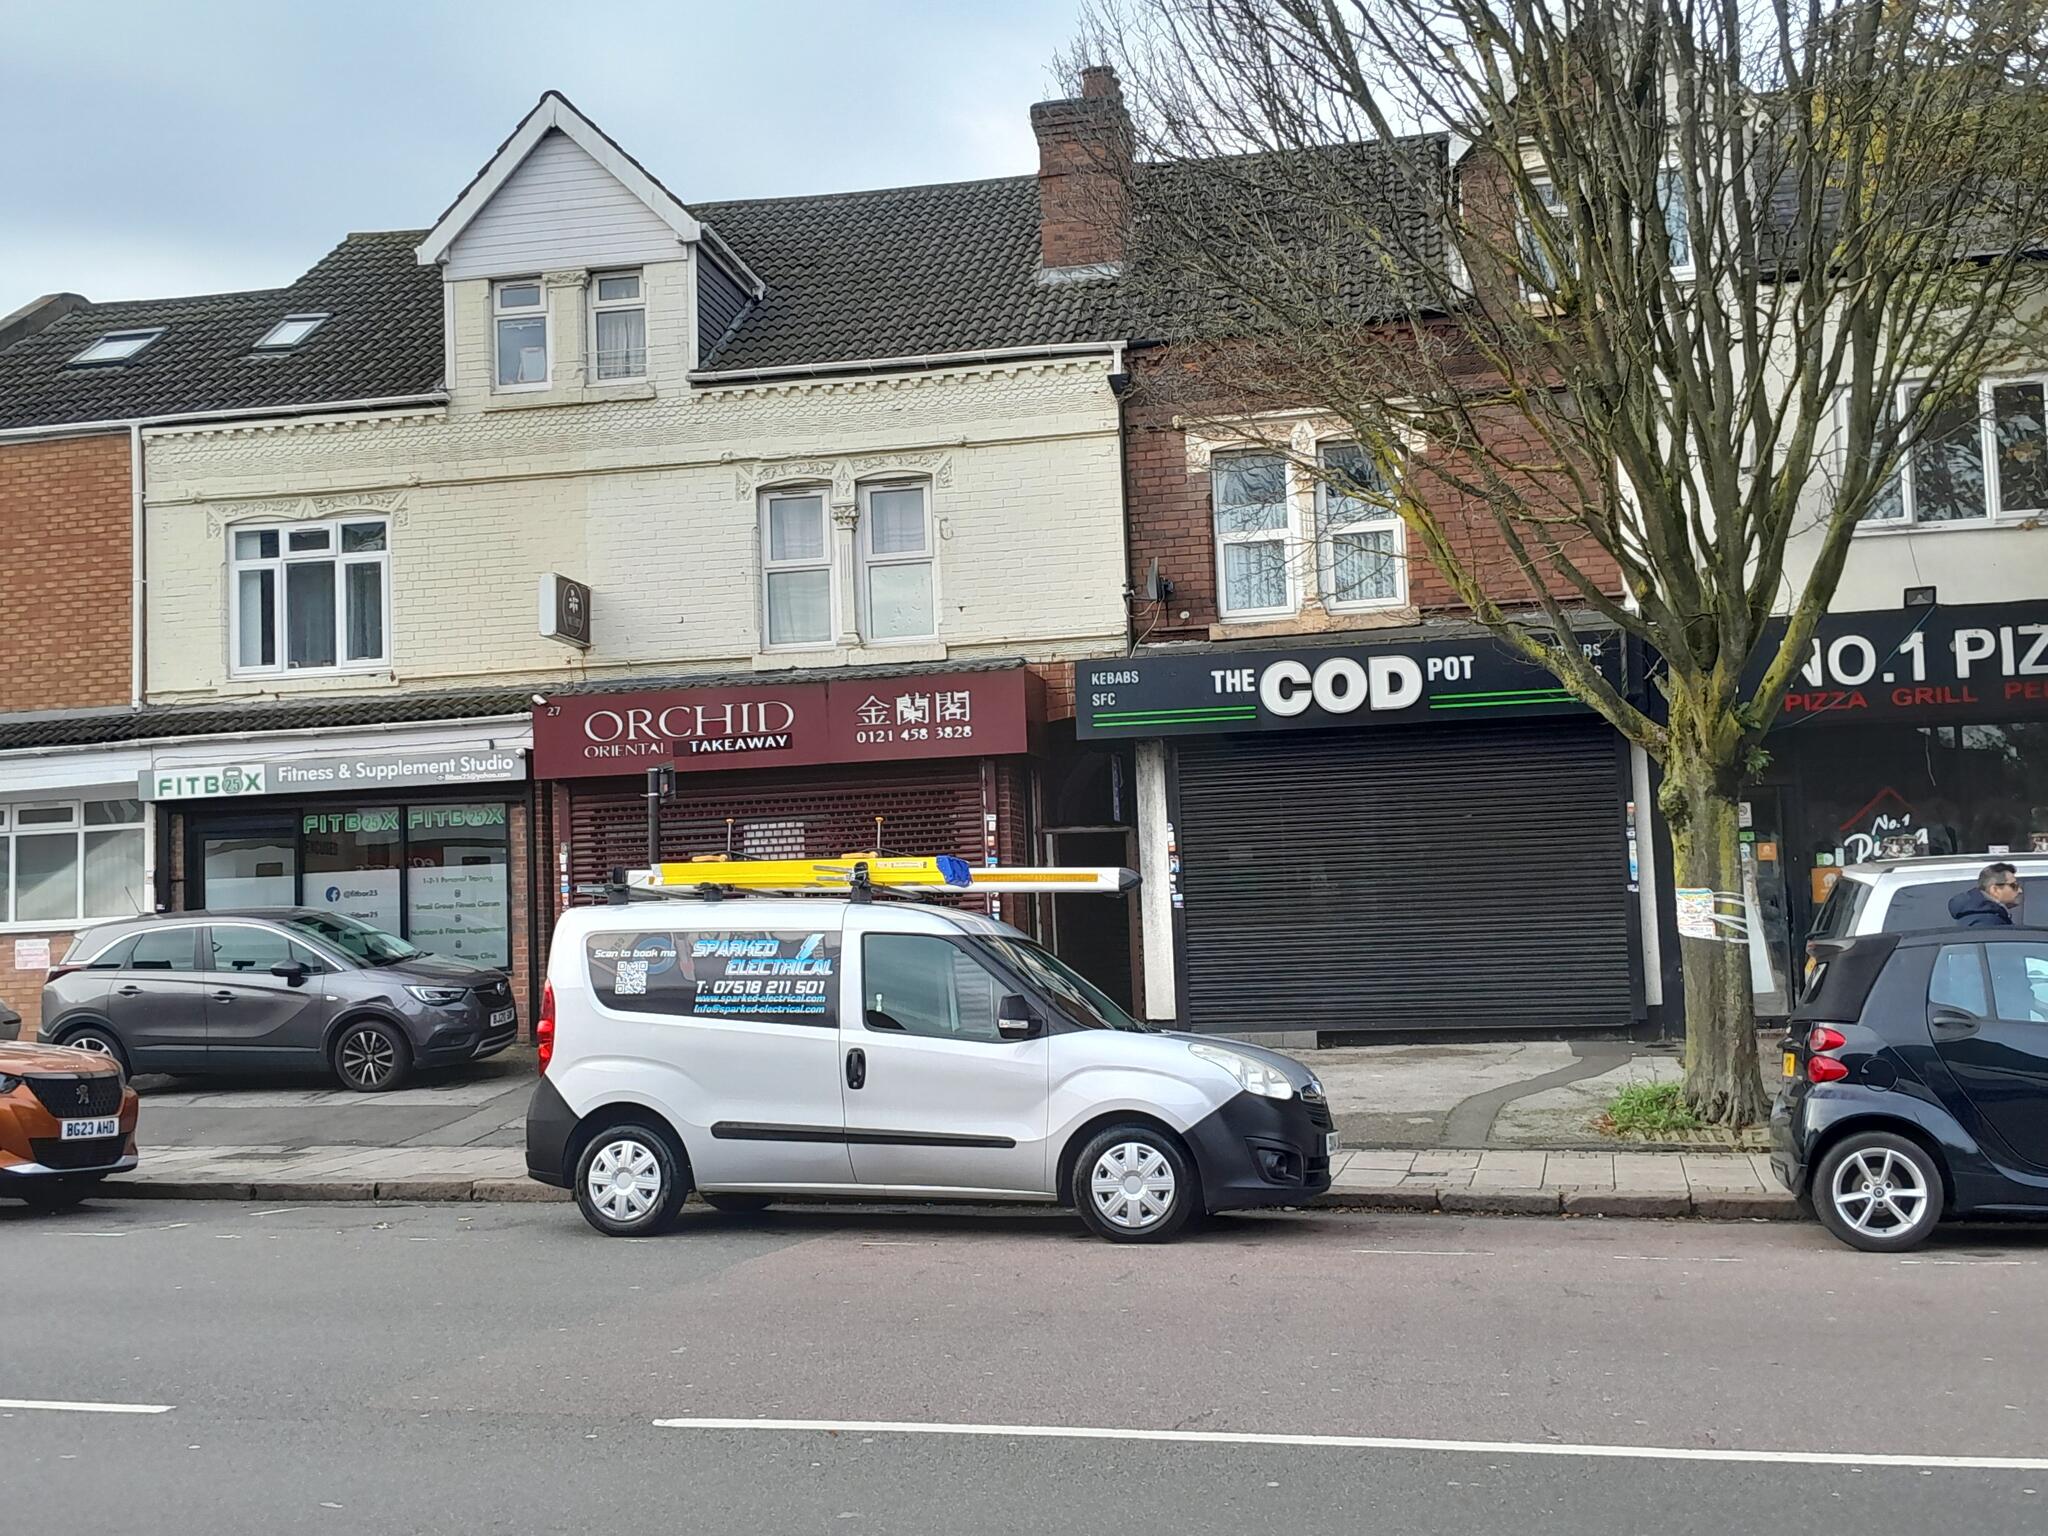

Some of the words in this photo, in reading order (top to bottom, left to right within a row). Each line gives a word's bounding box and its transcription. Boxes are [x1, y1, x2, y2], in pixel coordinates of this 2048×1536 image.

[1091, 670, 1140, 686] KEBABS
[1211, 668, 1256, 694] THE
[1259, 654, 1424, 717] COD
[1427, 655, 1475, 682] POT
[1092, 692, 1116, 706] SFC
[1784, 690, 1868, 712] PIZZA
[1891, 685, 1979, 706] GRILL
[2003, 680, 2048, 700] PE
[547, 706, 561, 717] 27
[855, 690, 970, 726] 金蘭閣
[583, 701, 795, 742] ORCHID
[856, 730, 893, 743] 0121
[900, 728, 929, 741] 458
[935, 725, 973, 739] 3828
[583, 743, 671, 759] ORIENTAL
[689, 735, 788, 753] TAKEAWAY
[278, 766, 334, 783] Fitness
[338, 763, 351, 779] &
[356, 758, 456, 781] Supplement
[460, 754, 514, 772] Studio
[1871, 813, 1912, 836] No.1
[1843, 828, 1929, 865] Pia
[593, 949, 619, 958] Scan
[620, 949, 632, 958] to
[632, 948, 659, 958] book
[660, 949, 677, 958] me
[691, 939, 780, 958] SPARKED
[724, 958, 834, 976] ELECTRICAL
[696, 980, 709, 994] T:
[713, 980, 763, 994] 07518
[765, 980, 792, 994] 211
[794, 980, 826, 994] 501
[695, 993, 826, 1005] www.sparked-electrical.com
[66, 1121, 95, 1137] BG23
[96, 1120, 115, 1135] AHD
